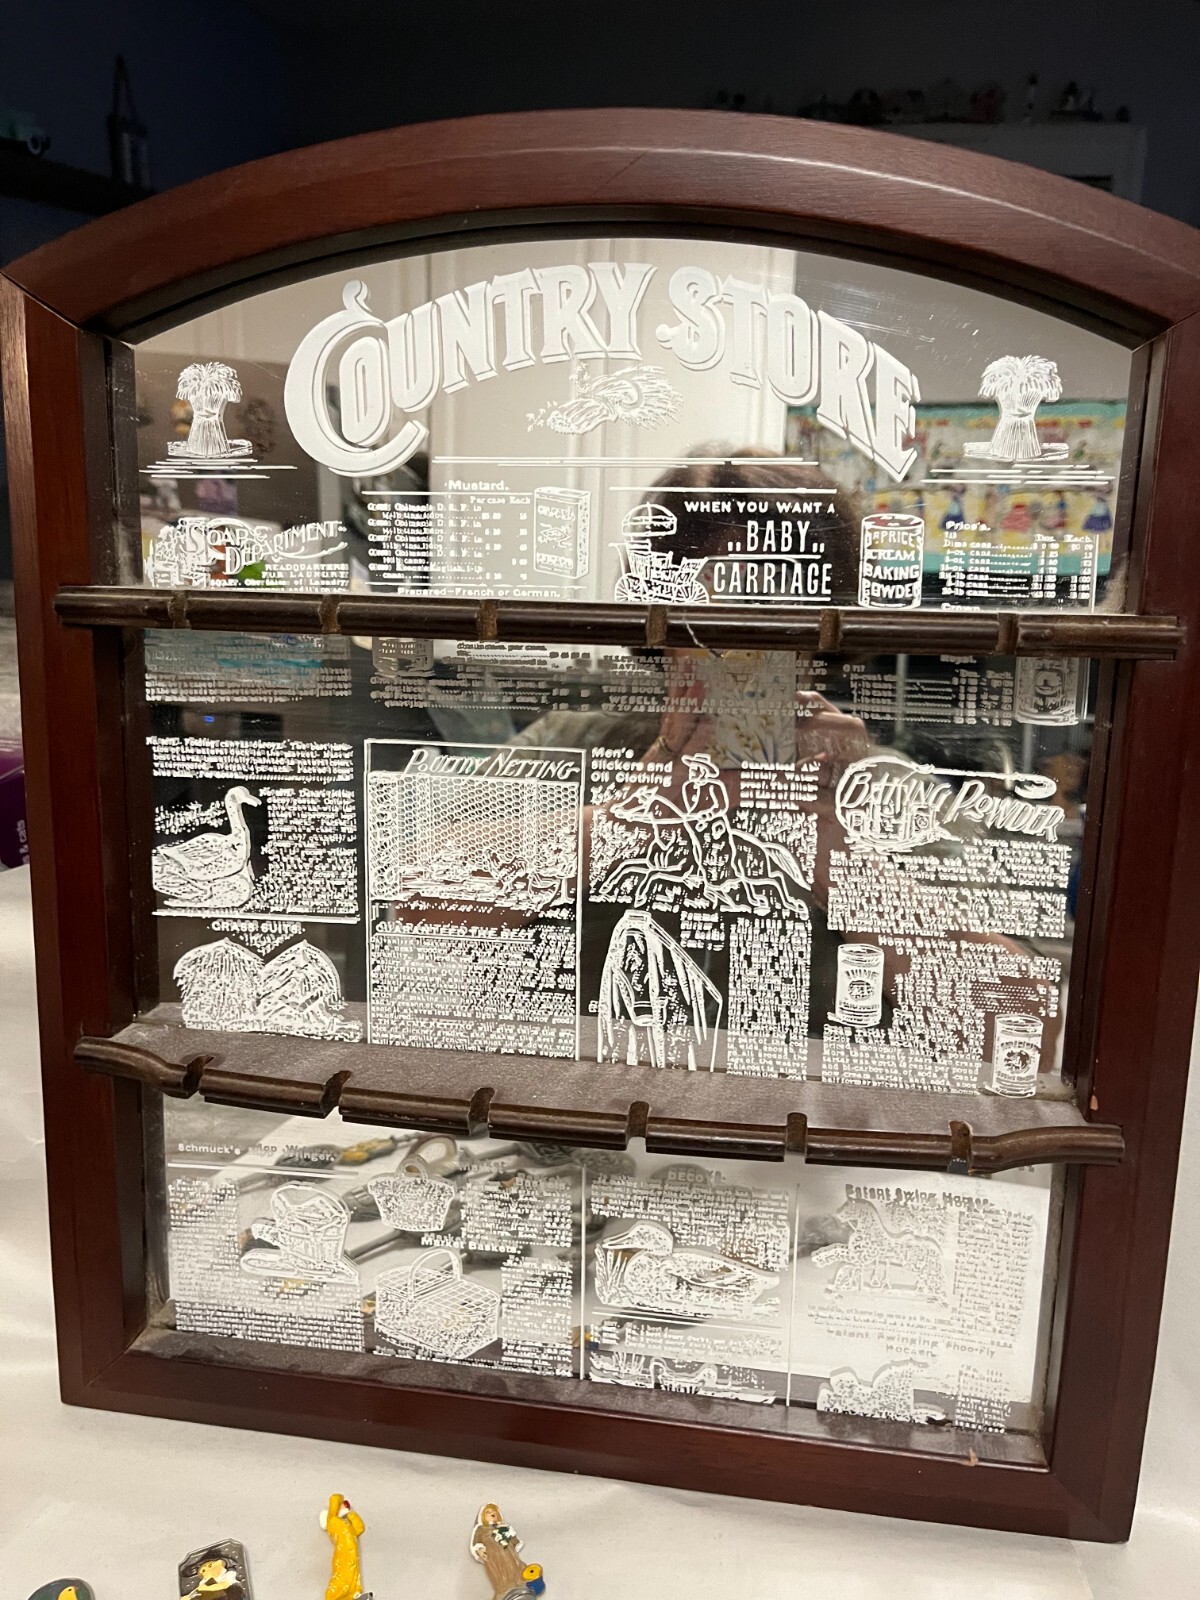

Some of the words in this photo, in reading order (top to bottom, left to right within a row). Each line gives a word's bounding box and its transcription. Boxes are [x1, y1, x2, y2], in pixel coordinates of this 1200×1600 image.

[284, 263, 658, 477] COUNTRY
[656, 266, 920, 482] STORE
[449, 480, 509, 490] Mustard.
[684, 501, 731, 512] WHEN
[738, 501, 768, 513] YOU
[777, 502, 822, 513] WANT
[827, 504, 835, 513] A
[747, 520, 810, 552] BABY
[224, 520, 342, 575] DEPARTMENT
[713, 562, 832, 595] CARRIAGE
[863, 563, 919, 580] BAKING
[592, 747, 634, 758] Men's
[403, 750, 491, 777] POULTRY
[483, 748, 579, 779] NETTING
[592, 759, 644, 771] Slickers
[647, 761, 673, 772] and
[591, 771, 609, 782] Oil
[616, 771, 672, 787] Clothing
[943, 780, 1065, 842] POWDER
[878, 935, 912, 947] Home
[916, 938, 957, 951] Baking
[178, 1143, 240, 1155] Schmuck's
